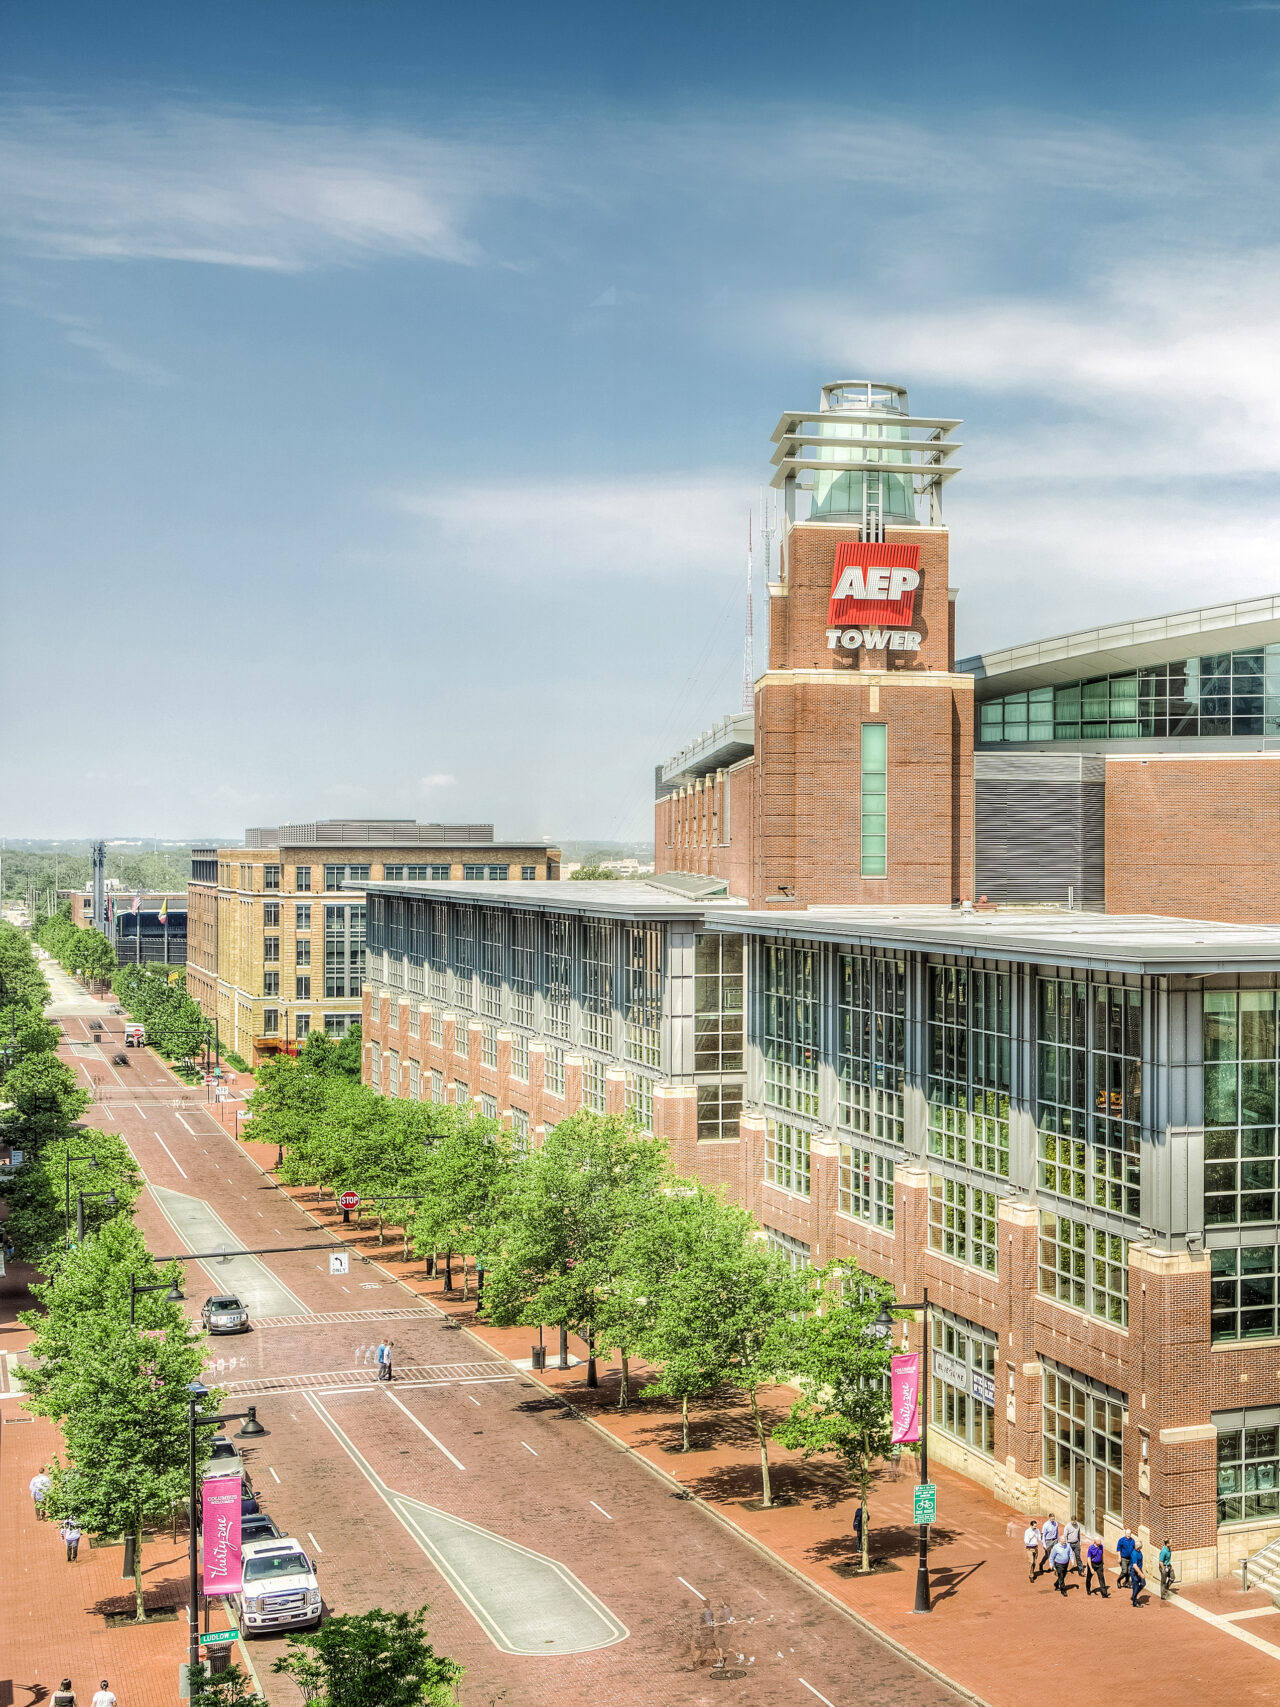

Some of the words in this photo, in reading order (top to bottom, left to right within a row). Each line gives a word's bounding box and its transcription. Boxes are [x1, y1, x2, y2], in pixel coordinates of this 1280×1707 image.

[832, 566, 920, 600] AEP
[826, 629, 922, 650] TOWER
[341, 1196, 359, 1204] STOP
[207, 1514, 238, 1578] thirty-one
[203, 1632, 230, 1642] LUDLOW
